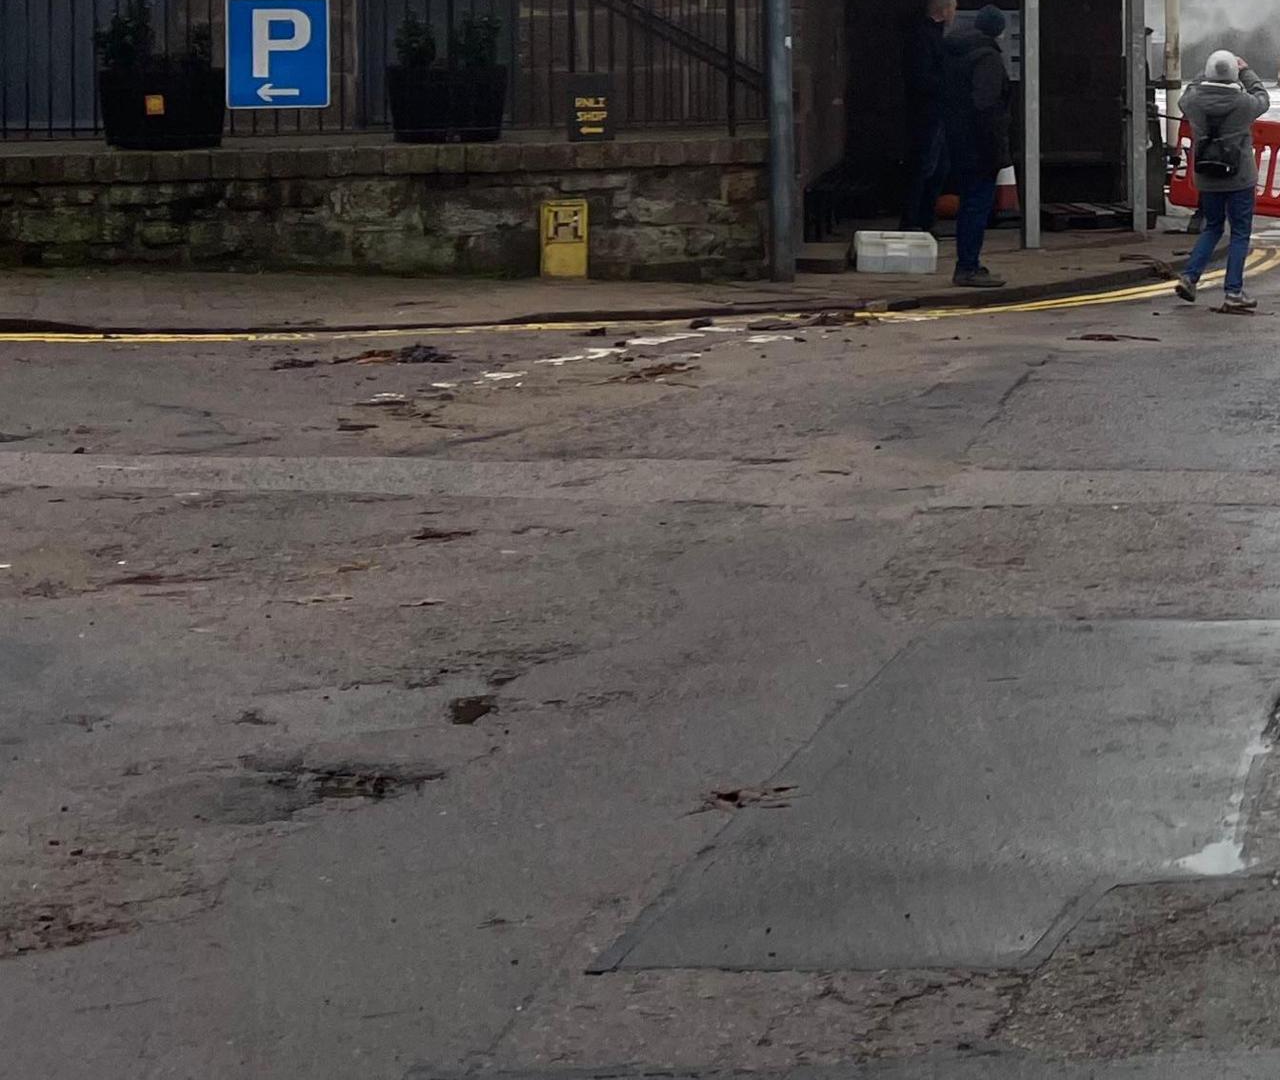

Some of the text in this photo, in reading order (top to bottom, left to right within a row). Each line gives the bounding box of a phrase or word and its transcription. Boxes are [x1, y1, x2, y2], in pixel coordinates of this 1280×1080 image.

[252, 8, 311, 78] P
[575, 97, 605, 107] RNLI
[576, 111, 607, 121] SHOP
[547, 208, 583, 240] H
